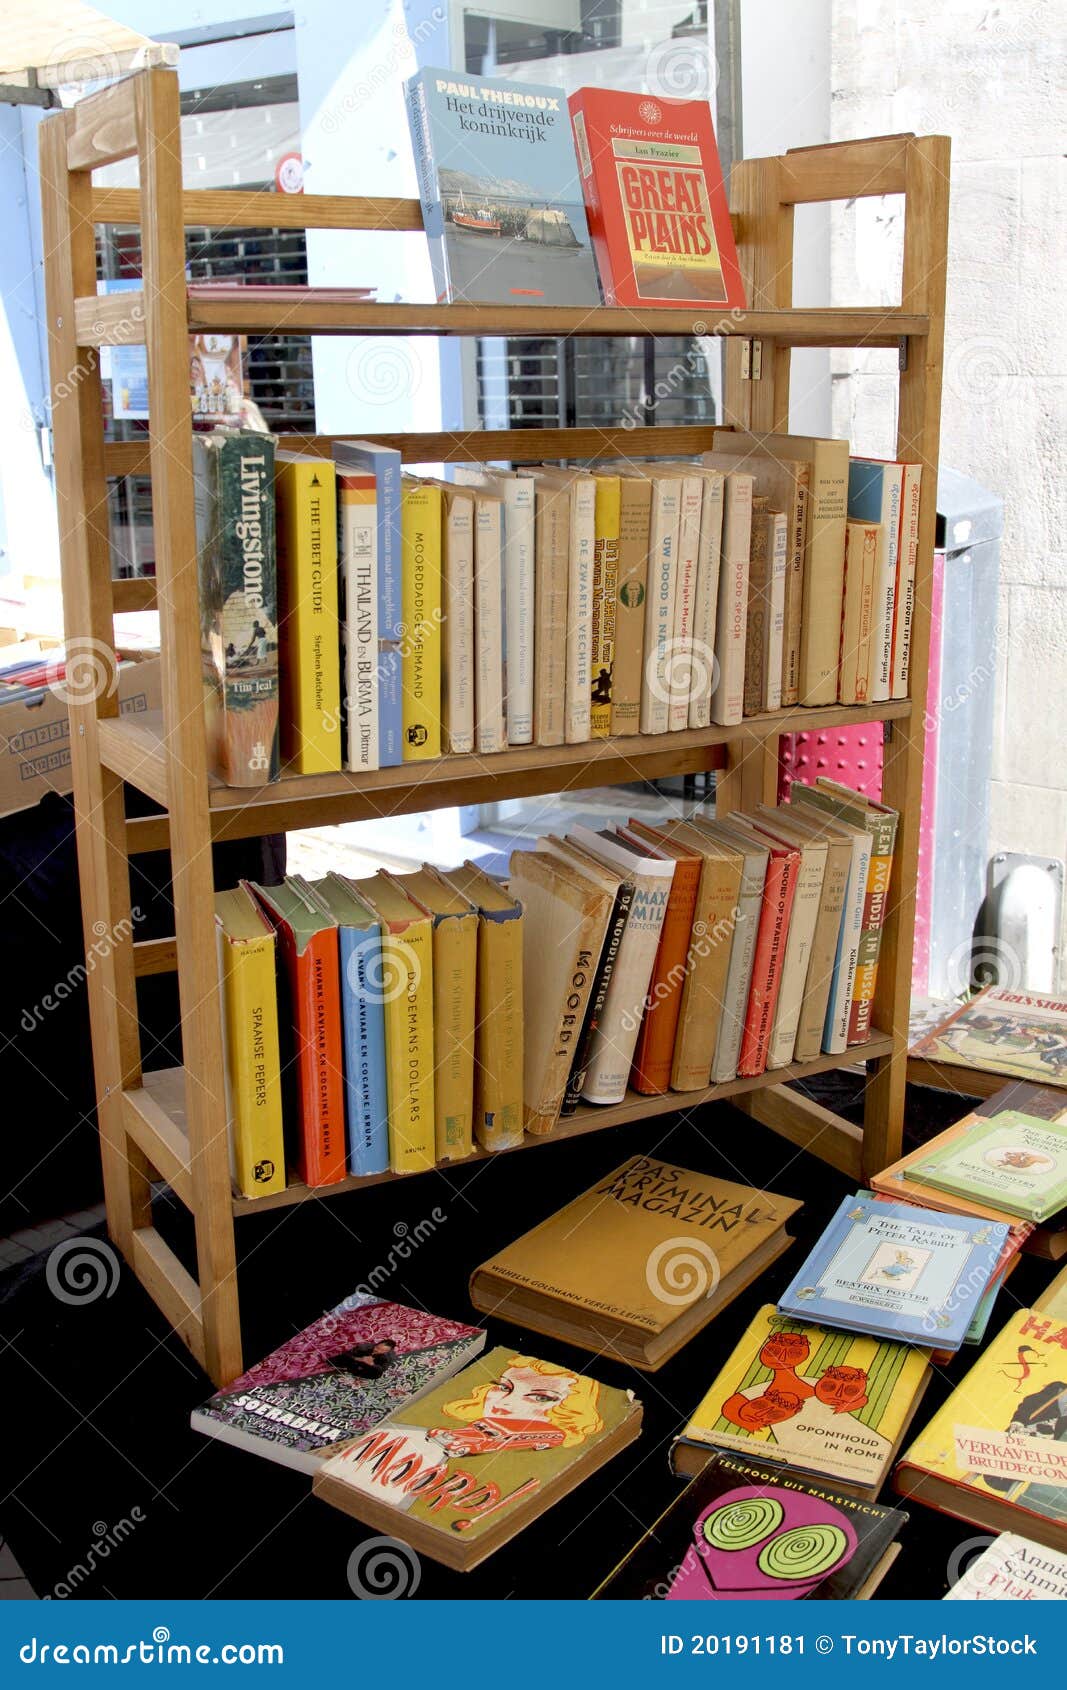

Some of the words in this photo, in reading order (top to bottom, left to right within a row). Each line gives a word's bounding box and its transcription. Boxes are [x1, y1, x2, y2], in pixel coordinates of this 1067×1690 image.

[436, 79, 480, 101] PAUL
[481, 89, 561, 112] THEROUX
[447, 96, 475, 117] Het
[478, 103, 555, 128] drijvende
[459, 115, 548, 146] koninkrijk
[674, 132, 698, 142] wereld
[650, 148, 680, 158] Frazier
[622, 166, 705, 215] GREAT
[632, 211, 712, 256] PLAINS
[383, 467, 393, 484] Was
[384, 486, 393, 494] ik
[311, 499, 320, 525] THE
[384, 496, 393, 505] in
[798, 490, 805, 501] OP
[890, 483, 900, 517] Robert
[910, 483, 919, 517] Robert
[796, 504, 804, 524] ZOEK
[889, 520, 897, 539] van
[909, 520, 917, 539] van
[236, 455, 265, 609] Livingstone
[311, 529, 321, 567] TIBET
[578, 539, 588, 555] DE
[662, 536, 671, 557] UW
[795, 527, 803, 548] NAAR
[384, 555, 393, 575] maar
[888, 542, 896, 568] Gulik
[908, 541, 916, 567] Gulik
[312, 569, 323, 615] GUIDE
[414, 532, 424, 629] MOORDDADIGE
[578, 562, 588, 617] ZWARTE
[660, 562, 670, 601] DOOD
[735, 563, 743, 598] DOOD
[357, 564, 372, 644] THAILAND
[382, 577, 395, 629] thuisgebleven
[659, 606, 668, 617] IS
[885, 587, 893, 620] Klokken
[904, 579, 914, 626] Fantoom
[733, 601, 742, 640] SPOOR
[903, 629, 910, 640] in
[314, 635, 322, 668] Stephen
[358, 646, 367, 659] EN
[578, 624, 587, 686] VECHTER
[232, 681, 252, 693] Tim
[255, 679, 272, 694] Jeal
[315, 671, 325, 711] Batchelor
[357, 661, 372, 717] BURMA
[877, 825, 892, 855] EEN
[779, 863, 791, 899] MOORD
[857, 852, 868, 885] Robert
[619, 896, 631, 912] DE
[634, 890, 668, 905] MAX
[777, 901, 786, 914] OP
[856, 887, 864, 904] van
[866, 861, 887, 931] AVONDJE
[771, 916, 783, 953] ZWARTE
[853, 906, 862, 931] Gulik
[865, 937, 878, 953] IN
[315, 958, 323, 999] HAVANK
[766, 954, 778, 993] MARTHA
[847, 949, 857, 980] Klokken
[737, 972, 747, 994] VAN
[845, 983, 853, 997] van
[855, 958, 876, 1032] MUSCADIN
[317, 1004, 326, 1052] CAVIAAR
[359, 996, 368, 1041] CAVIAAR
[407, 971, 419, 1053] DODEMANS
[760, 1000, 771, 1032] MICHEL
[252, 1007, 265, 1060] SPAANSE
[319, 1054, 326, 1066] EN
[360, 1044, 368, 1057] EN
[255, 1064, 267, 1107] PEPERS
[320, 1071, 329, 1117] COCAINE
[361, 1062, 370, 1108] COCAINE
[409, 1059, 421, 1123] DOLLARS
[322, 1123, 331, 1158] BRUNA
[363, 1114, 372, 1149] BRUNA
[628, 1158, 687, 1183] DAS
[596, 1182, 742, 1233] MAGAZIN
[613, 1170, 777, 1225] KRIMINAL-
[868, 1226, 906, 1240] PETER
[911, 1235, 956, 1249] RABBIT
[878, 1220, 902, 1231] THE
[905, 1225, 938, 1239] TALE
[490, 1264, 531, 1283] WILHELM
[530, 1279, 583, 1302] GOLDMANN
[583, 1297, 619, 1315] VERLAG
[618, 1308, 658, 1328] LEIPZIG
[835, 1279, 881, 1293] BEATRIX
[886, 1288, 929, 1302] POTTER
[233, 1395, 343, 1441] SOERABAJA
[247, 1385, 286, 1407] Paul
[286, 1398, 351, 1431] Theroux
[795, 1424, 880, 1448] OPONTHOUD
[824, 1440, 841, 1451] IN
[844, 1446, 884, 1462] ROME
[1005, 1435, 1026, 1447] DE
[718, 1458, 780, 1484] TELEFOON
[784, 1480, 806, 1492] UIT
[808, 1486, 888, 1520] MAASTRICHT
